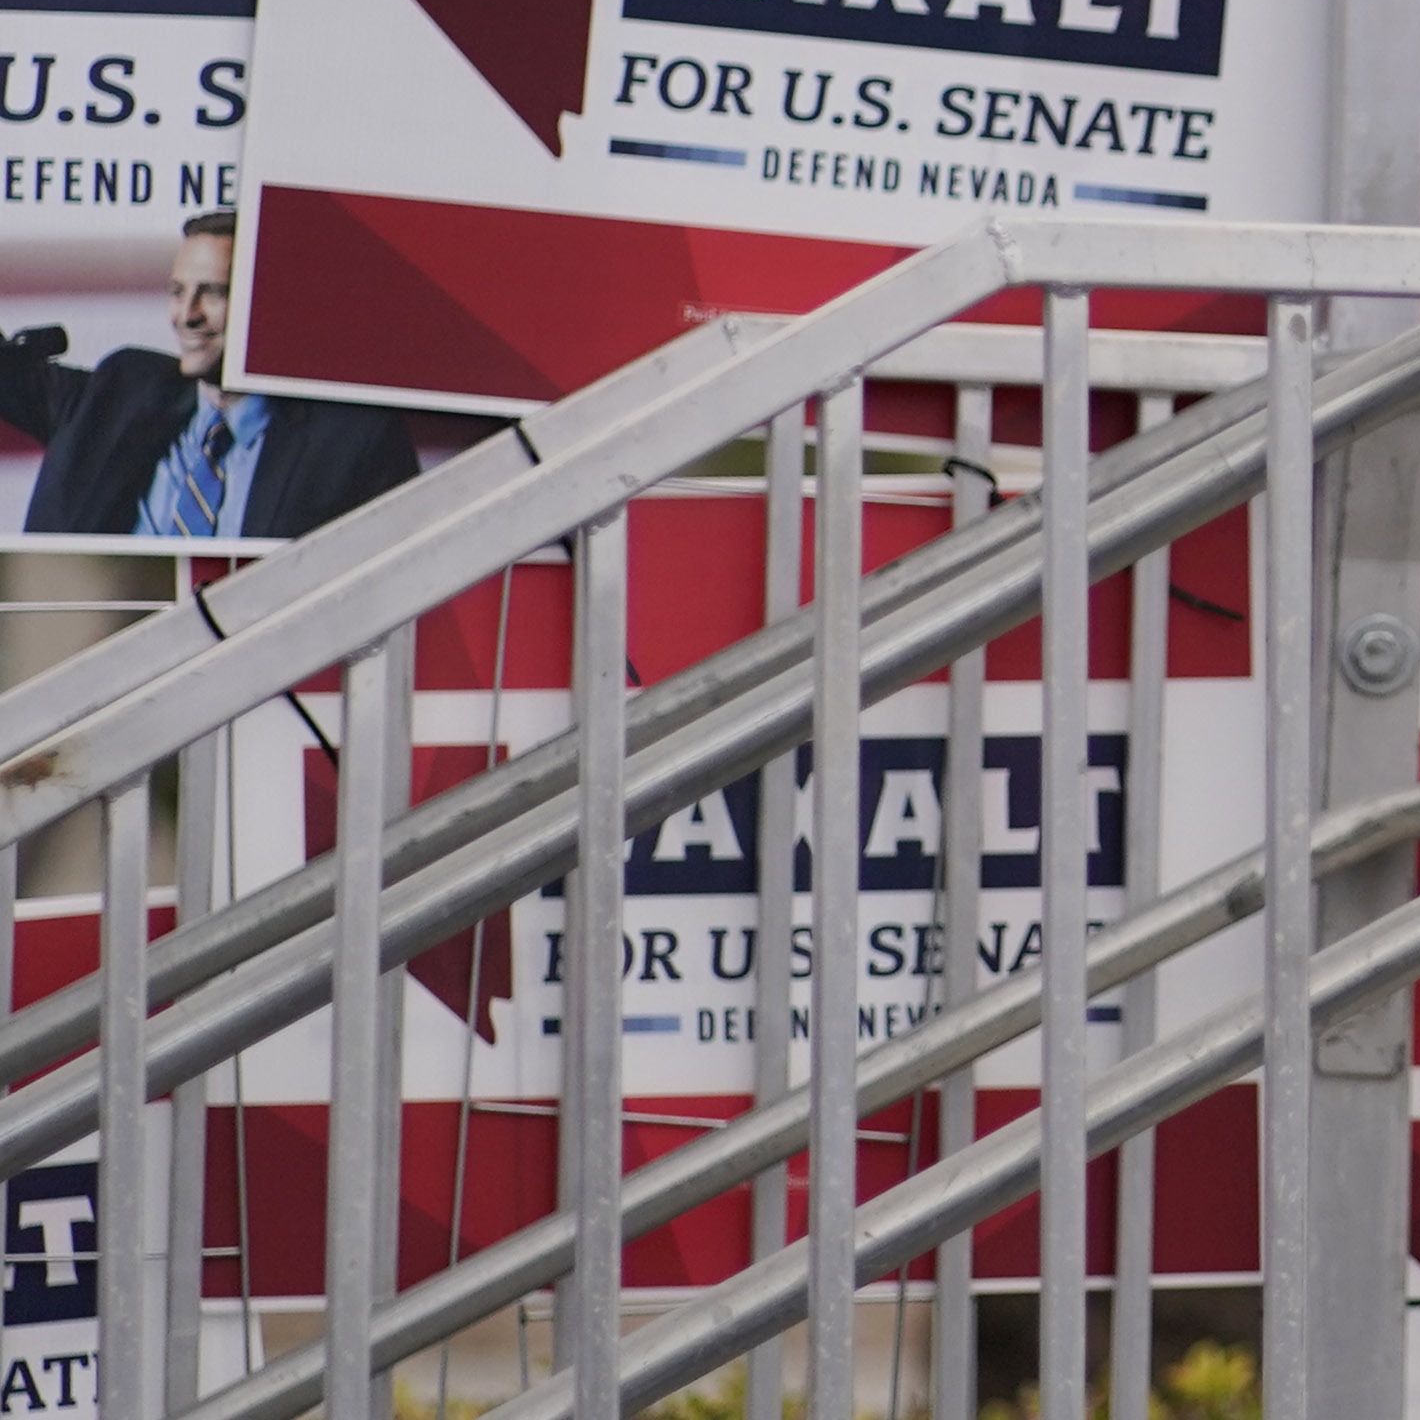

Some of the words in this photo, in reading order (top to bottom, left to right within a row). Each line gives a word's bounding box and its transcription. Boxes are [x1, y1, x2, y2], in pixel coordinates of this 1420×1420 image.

[614, 54, 754, 117] FOR
[781, 69, 911, 134] U.S.
[936, 85, 1214, 161] SENATE
[6, 158, 153, 204] EFEND
[762, 147, 902, 193] DEFEND
[919, 164, 1061, 209] NEVADA
